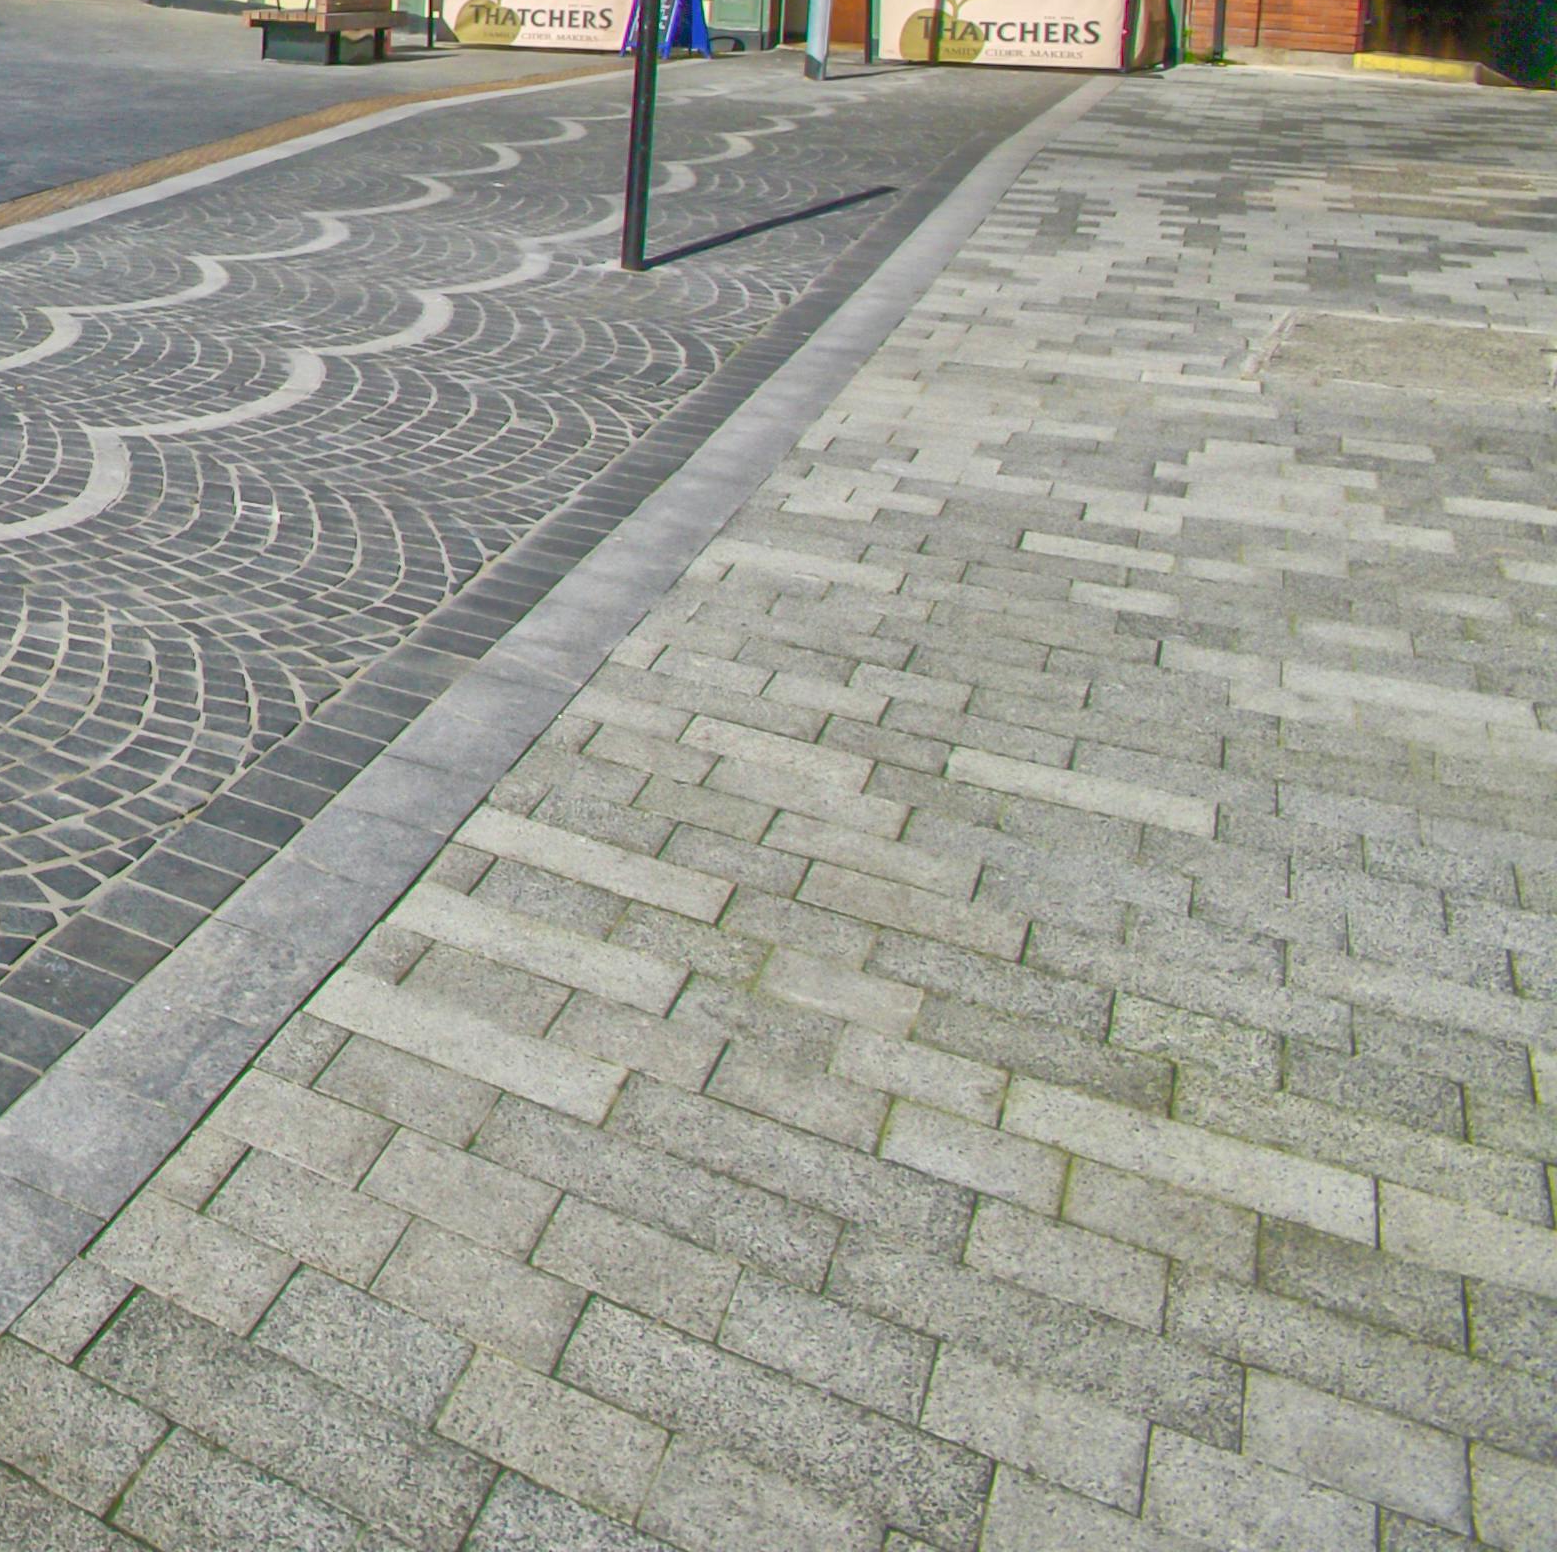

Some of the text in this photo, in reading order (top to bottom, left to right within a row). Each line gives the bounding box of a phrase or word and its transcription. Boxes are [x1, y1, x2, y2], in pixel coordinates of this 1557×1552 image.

[470, 4, 614, 30] THATCHERS
[917, 15, 1102, 45] THATCHERS
[985, 48, 1023, 58] CIDER
[1028, 49, 1084, 59] MAKERS
